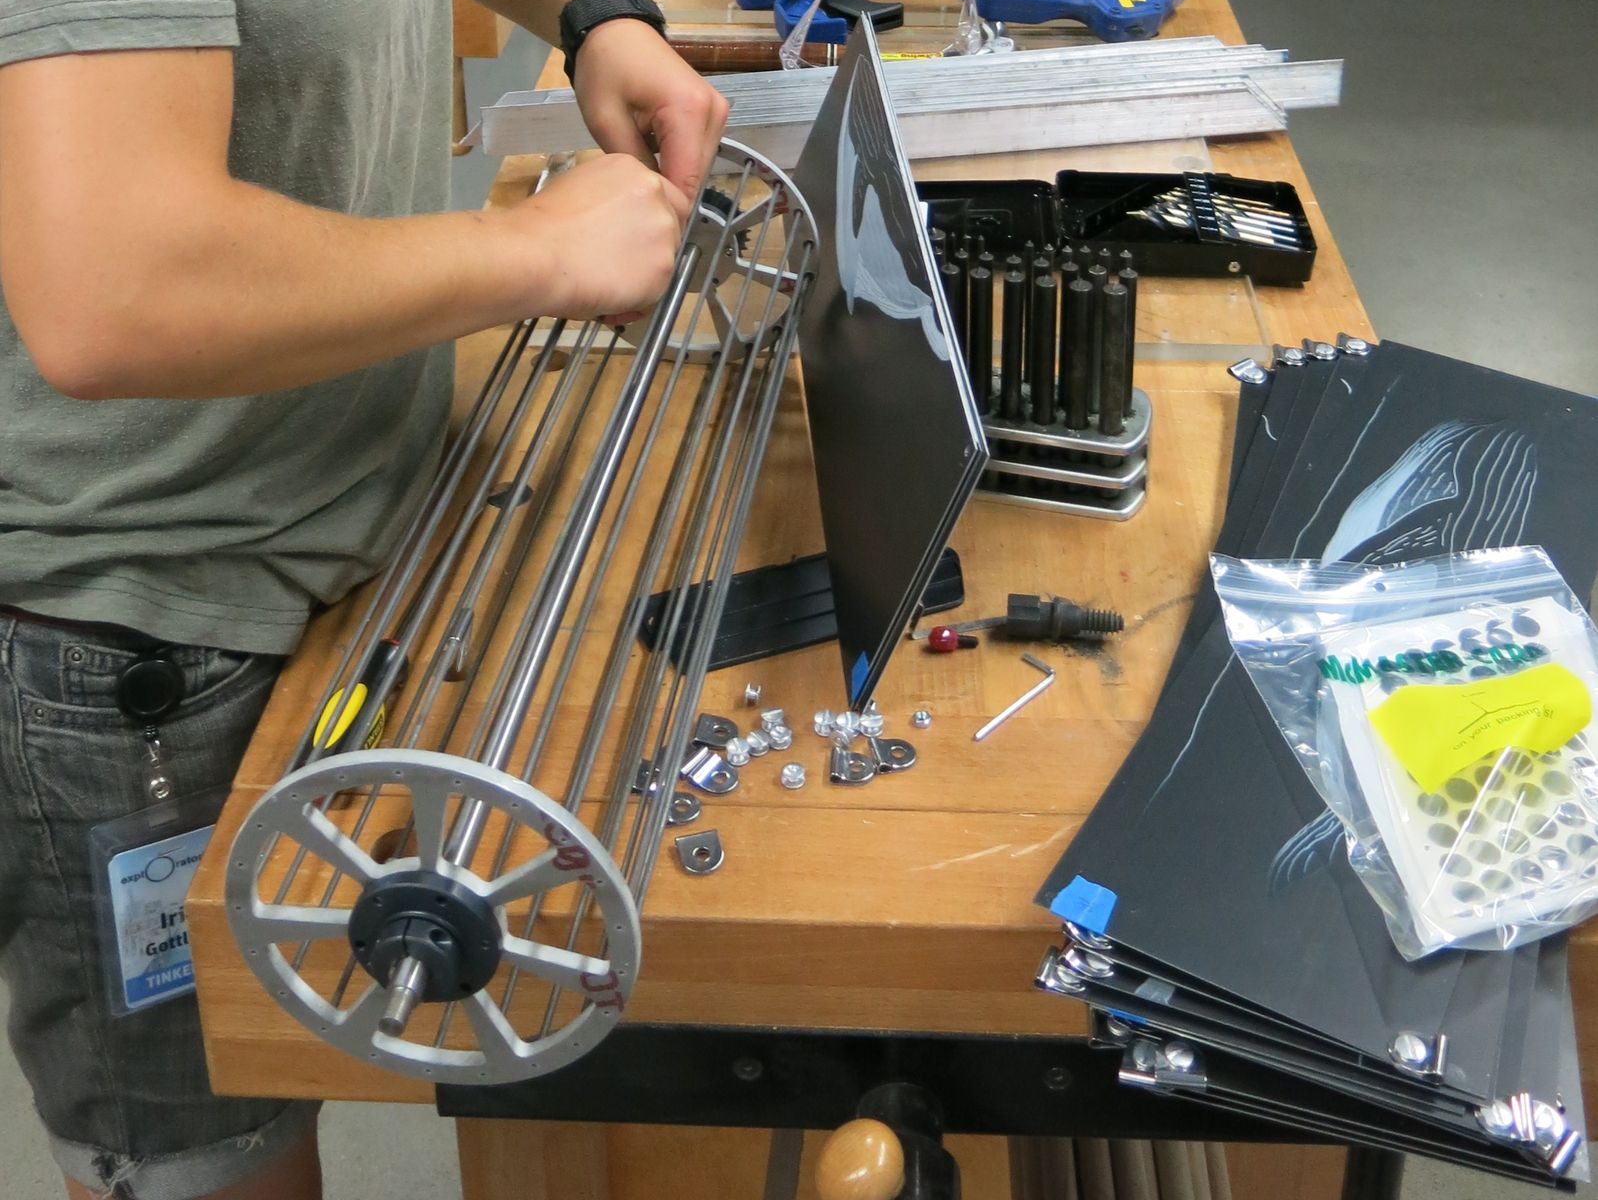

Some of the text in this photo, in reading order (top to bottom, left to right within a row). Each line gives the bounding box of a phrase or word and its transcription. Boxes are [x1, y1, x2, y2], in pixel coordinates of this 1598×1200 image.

[1469, 721, 1491, 740] your
[1496, 705, 1541, 725] packing
[161, 906, 186, 929] Iri
[146, 931, 189, 956] Gottl
[146, 964, 192, 989] TINKE
